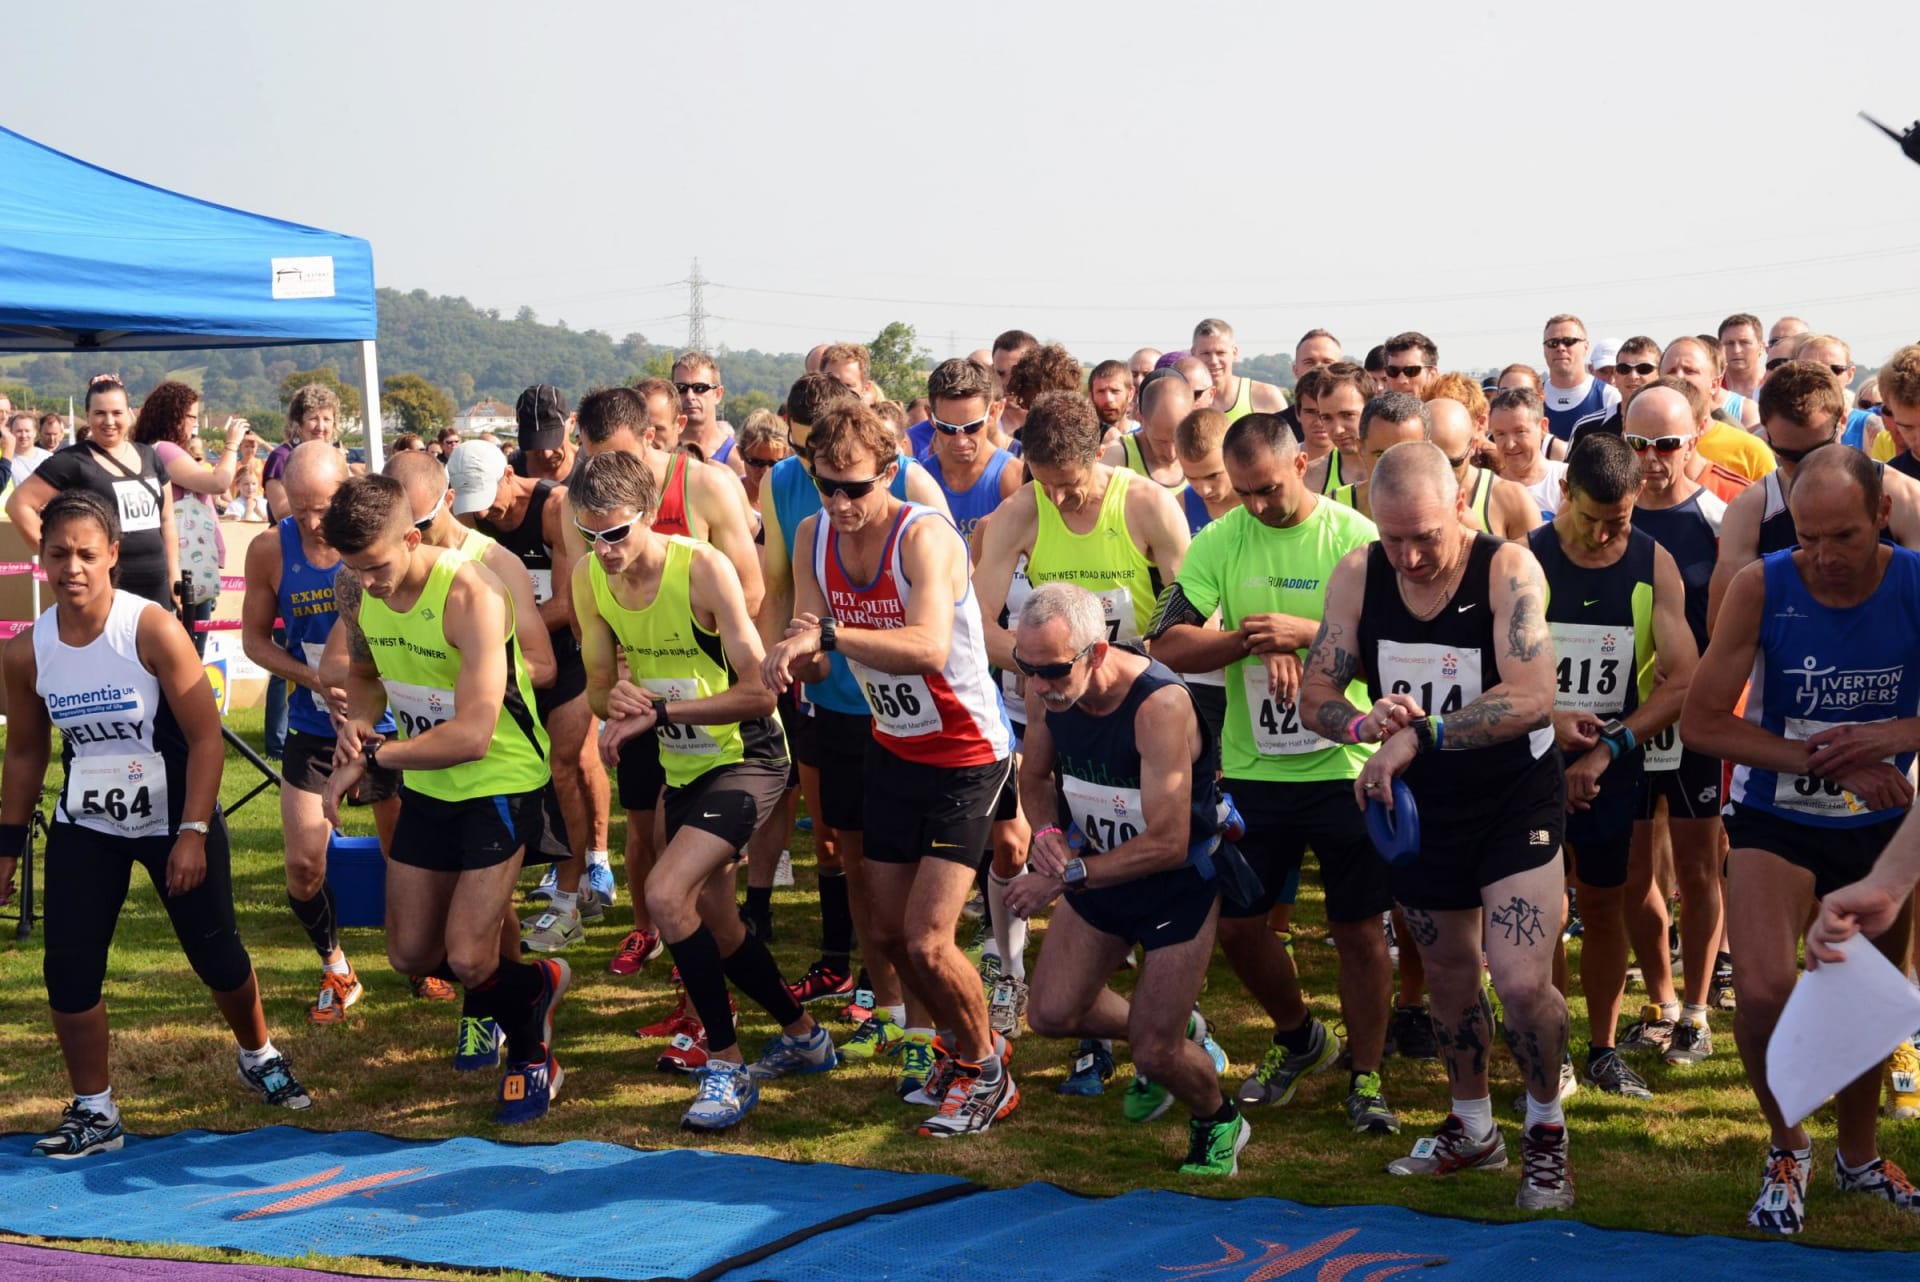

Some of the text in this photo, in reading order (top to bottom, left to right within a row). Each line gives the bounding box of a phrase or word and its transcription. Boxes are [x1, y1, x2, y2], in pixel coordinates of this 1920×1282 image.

[1058, 570, 1078, 580] WEST
[1080, 569, 1099, 579] ROAD
[1100, 569, 1136, 580] RUNNERS
[291, 587, 334, 604] EXMO
[379, 637, 397, 647] WEST
[413, 645, 447, 660] RUNNERS
[1556, 656, 1619, 695] 413
[49, 683, 136, 709] Dementia UK
[865, 681, 921, 718] 656
[1259, 698, 1299, 735] 42
[82, 785, 153, 822] 564
